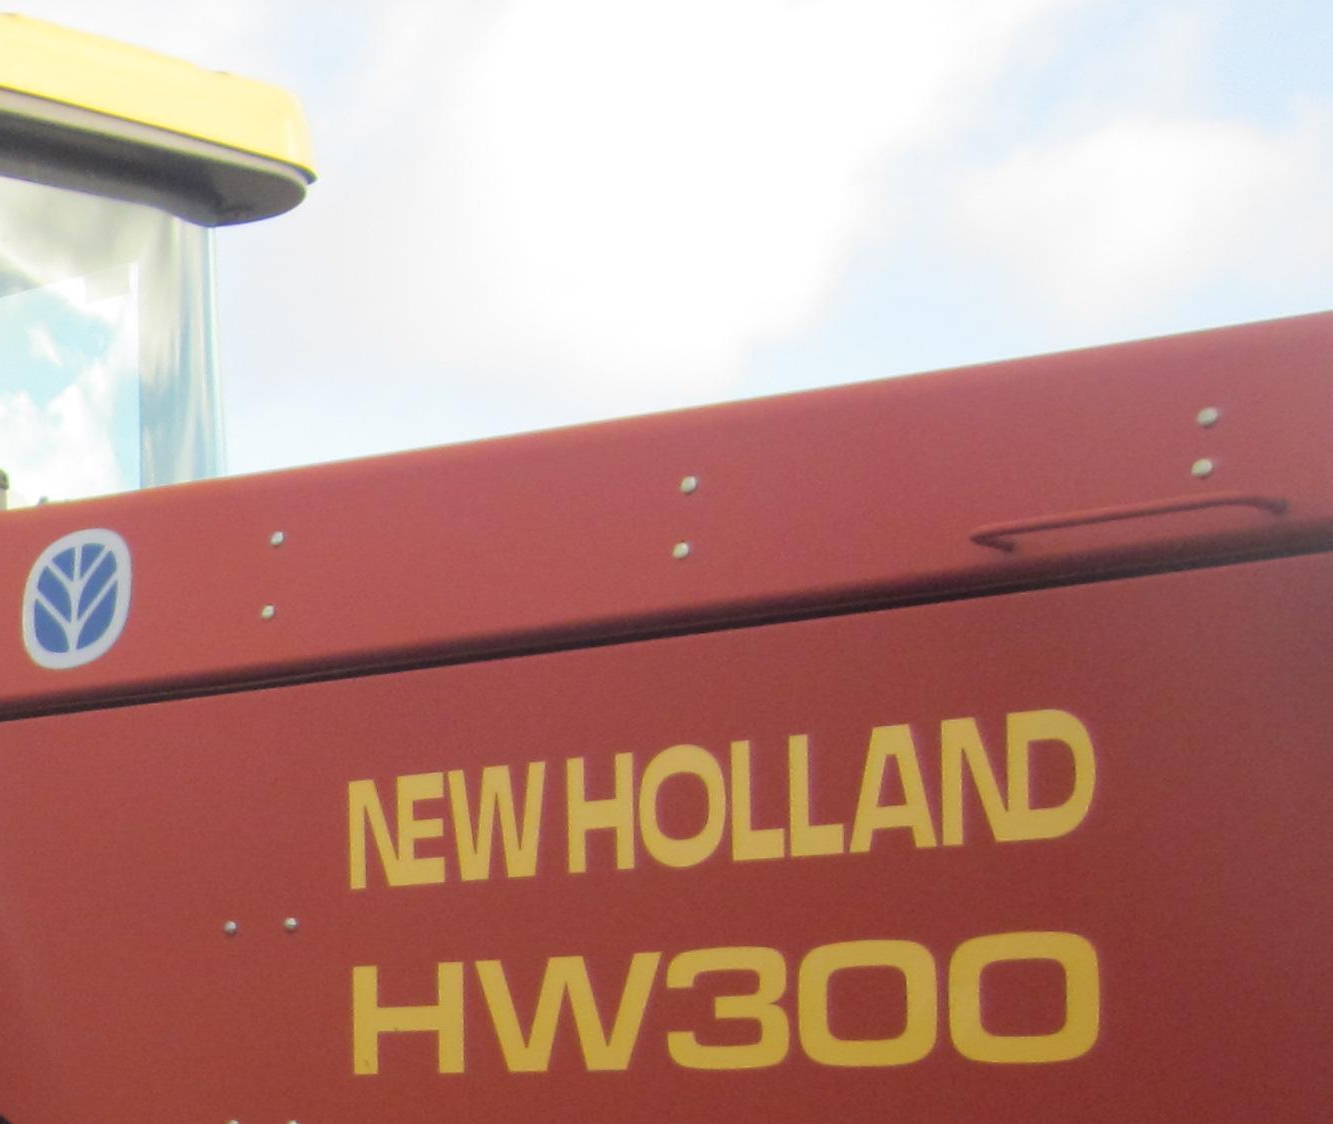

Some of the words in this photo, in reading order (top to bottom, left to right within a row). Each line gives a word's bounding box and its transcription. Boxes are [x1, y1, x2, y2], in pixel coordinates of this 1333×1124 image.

[347, 760, 547, 890] NEW
[566, 708, 1097, 875] HOLLAND
[352, 930, 1101, 1076] HW300
